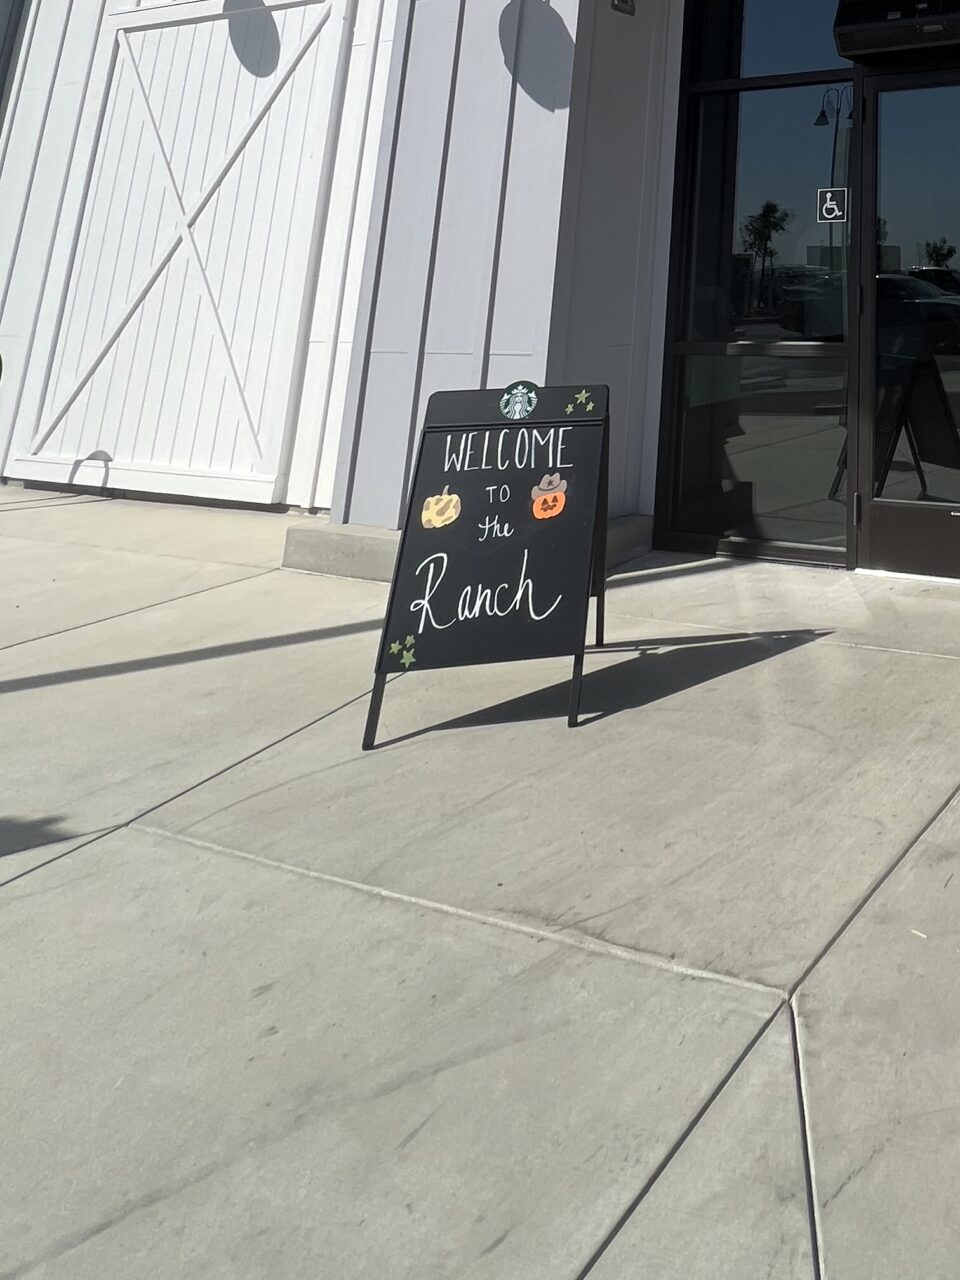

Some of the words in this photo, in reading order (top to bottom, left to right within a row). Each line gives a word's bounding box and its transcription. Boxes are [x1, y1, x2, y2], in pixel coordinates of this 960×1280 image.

[444, 427, 573, 471] WELCOME
[485, 485, 511, 503] TO
[478, 515, 514, 542] the
[409, 548, 562, 634] Ranch
